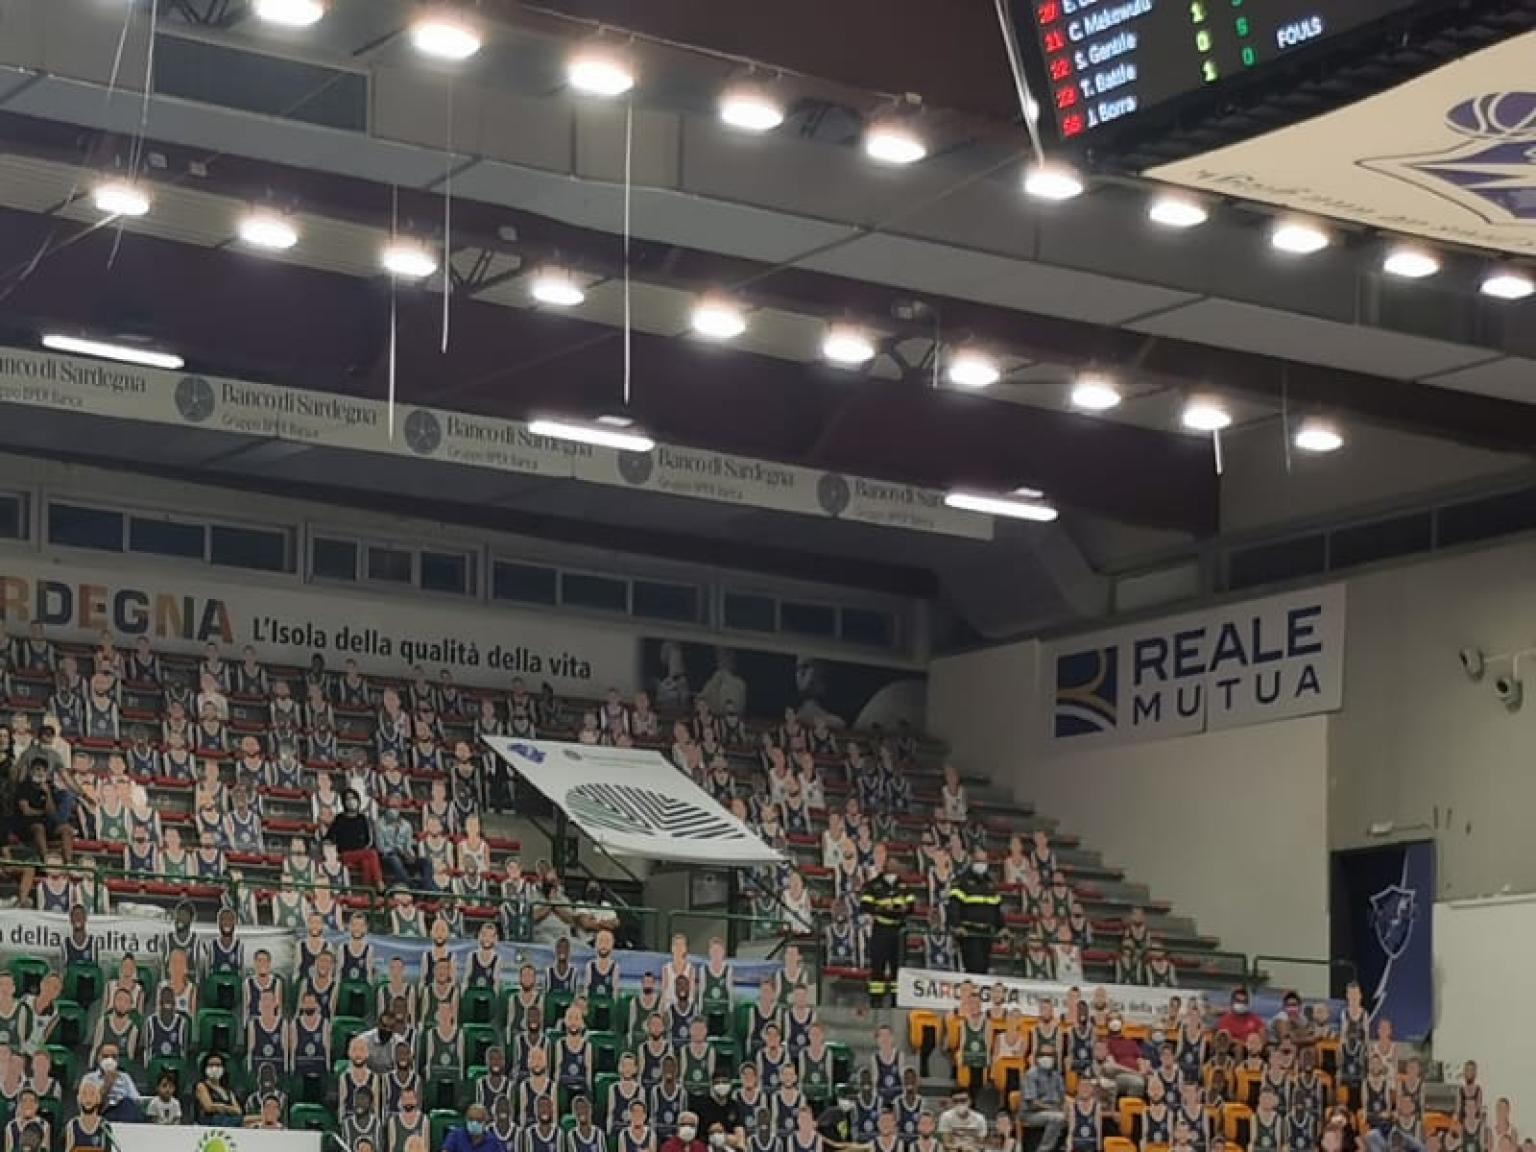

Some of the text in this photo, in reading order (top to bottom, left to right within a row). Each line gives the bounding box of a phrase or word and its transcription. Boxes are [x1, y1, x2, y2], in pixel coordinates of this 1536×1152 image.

[1276, 16, 1323, 49] FOULS
[40, 358, 57, 380] di
[60, 360, 147, 393] Sardegna
[222, 383, 377, 425] Banco di Sardegna
[447, 415, 498, 441] Banco
[500, 425, 513, 445] di
[335, 626, 392, 657] della
[399, 639, 481, 666] qualità
[486, 645, 543, 675] della
[547, 652, 592, 681] vita
[1133, 604, 1322, 687] REALE
[1132, 663, 1321, 726] MUTUA
[11, 923, 62, 949] della
